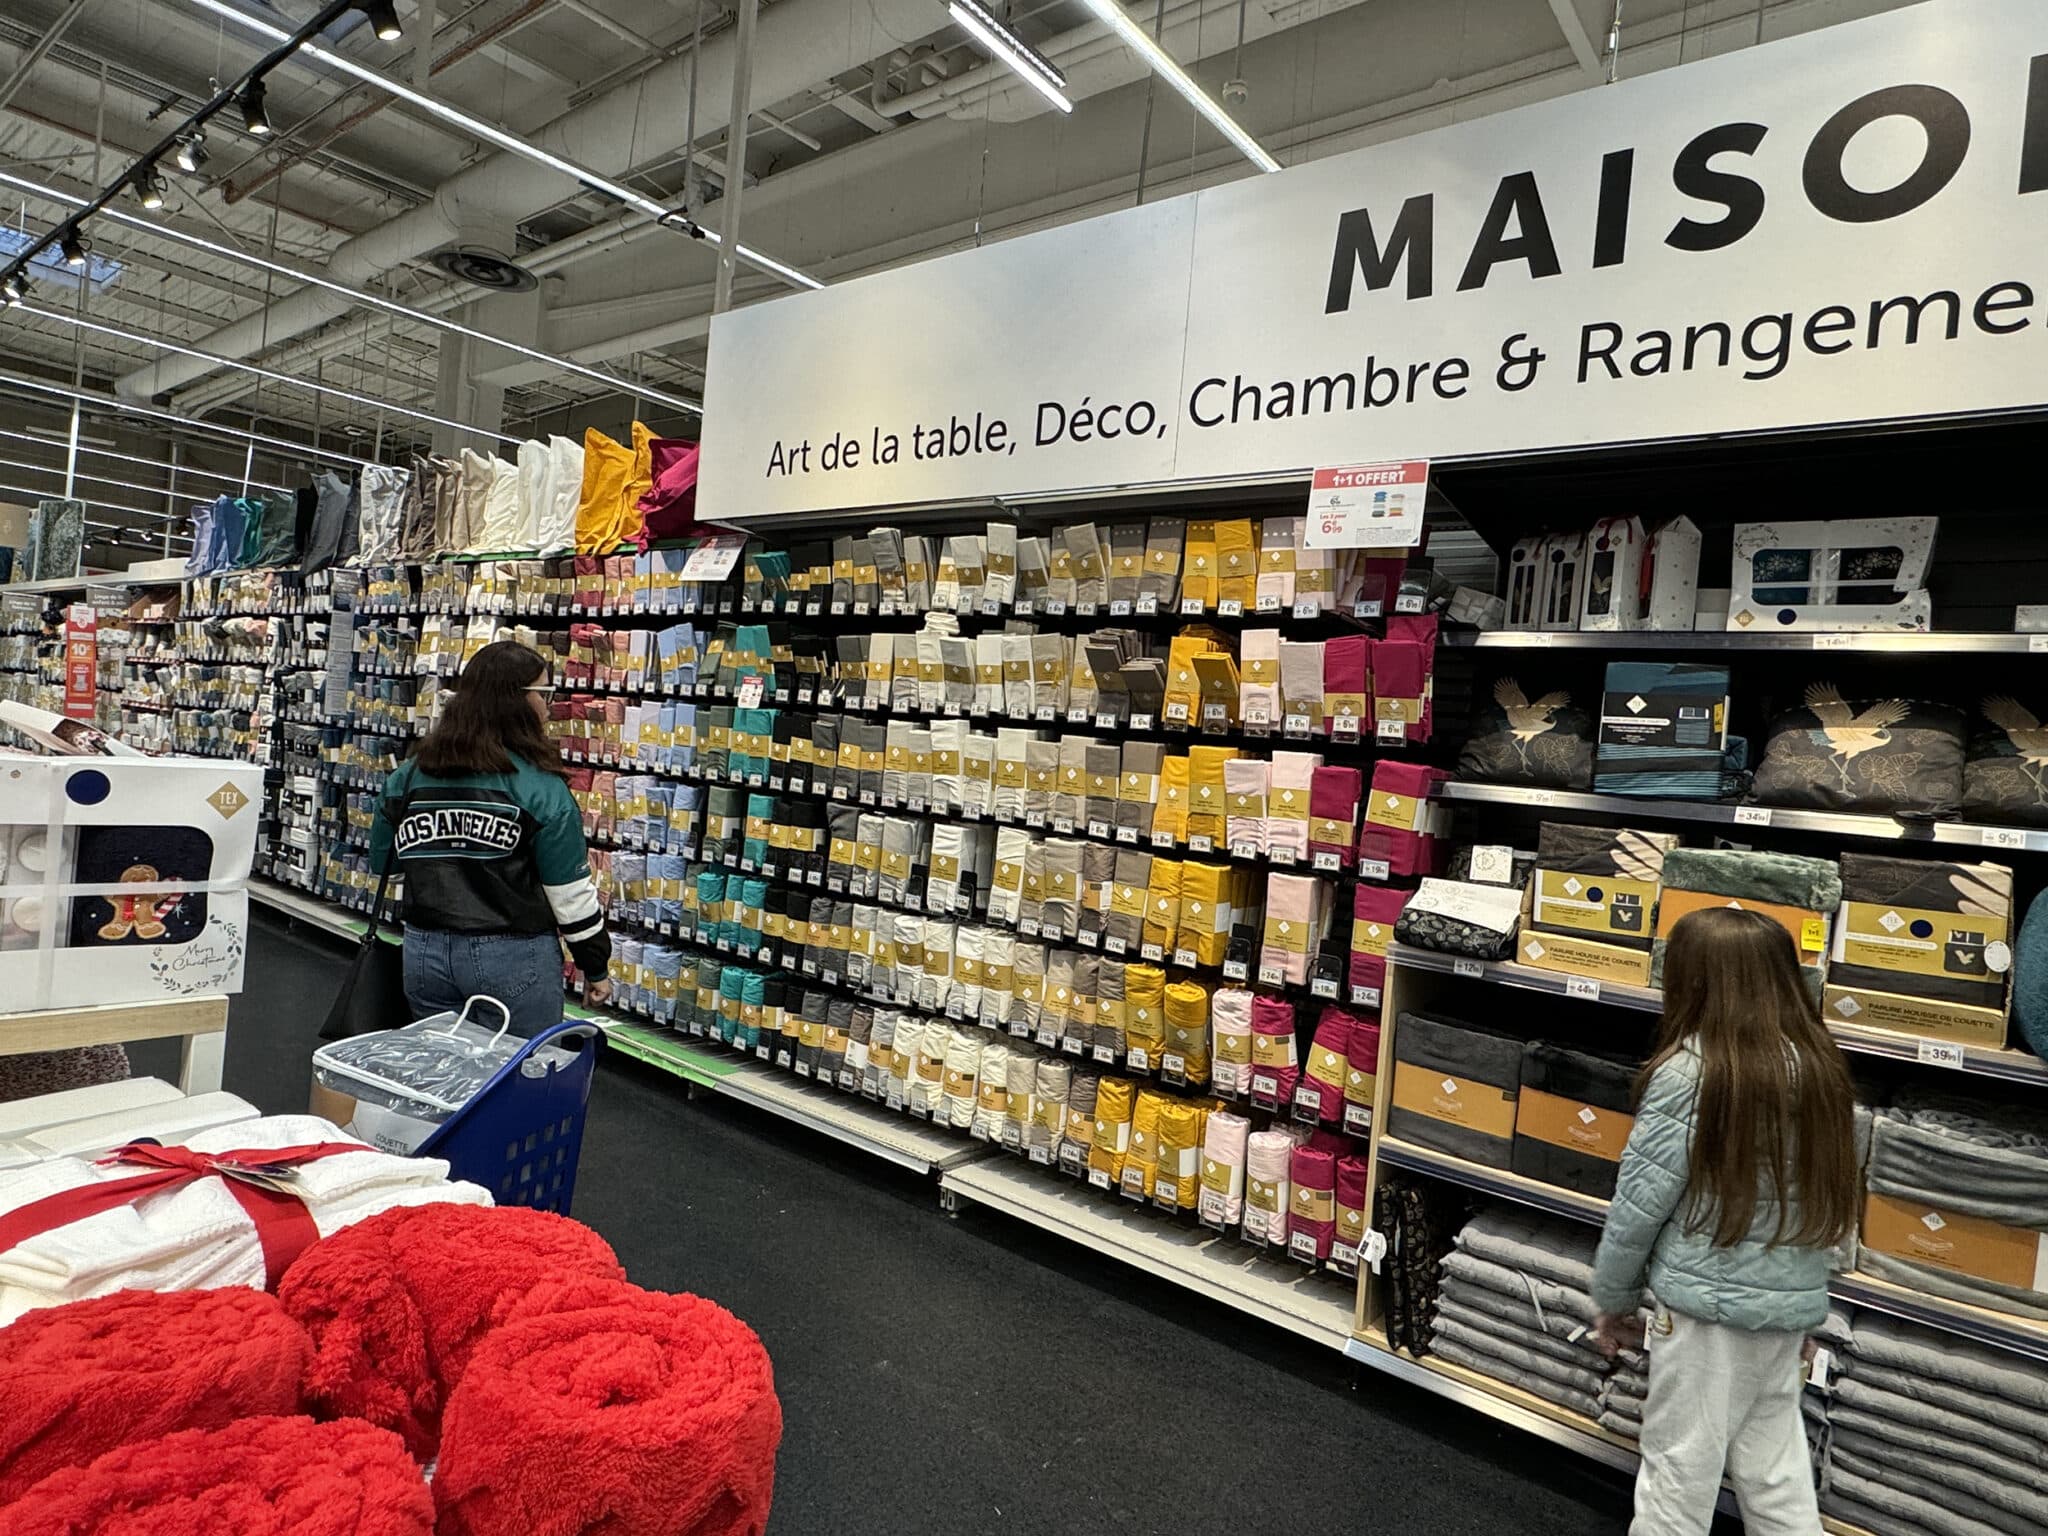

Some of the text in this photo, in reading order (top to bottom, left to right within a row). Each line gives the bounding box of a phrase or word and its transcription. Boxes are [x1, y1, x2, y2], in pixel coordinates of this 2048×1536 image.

[766, 282, 2048, 478] Art de la table, Déco, Chambre & Rangeme
[1333, 471, 1406, 487] 1+1 OFFERT
[219, 791, 238, 805] TEX
[396, 808, 522, 853] LOS ANGELES
[181, 944, 214, 958] Merry
